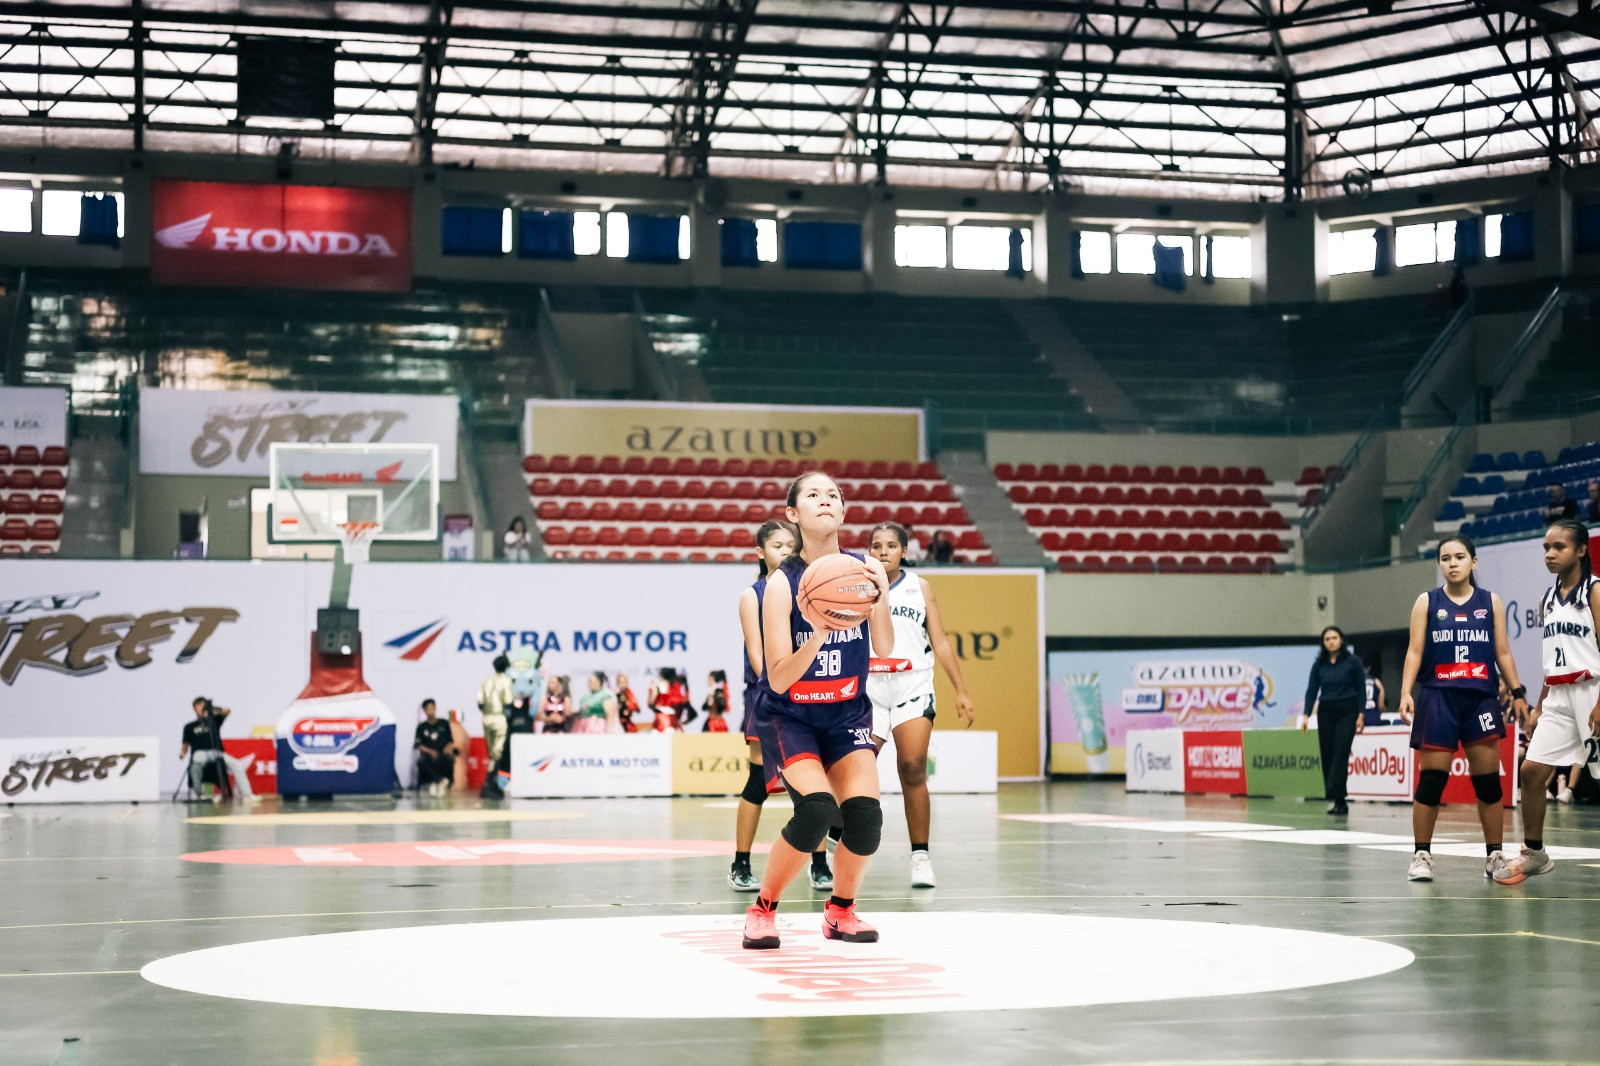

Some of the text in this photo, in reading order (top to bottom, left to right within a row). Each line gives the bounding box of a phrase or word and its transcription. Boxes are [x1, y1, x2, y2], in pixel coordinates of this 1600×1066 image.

[213, 228, 397, 257] HONDA
[889, 605, 922, 622] ARRY
[457, 631, 688, 652] ASTRA MOTOR
[1432, 630, 1490, 643] BUDI UTAMA
[815, 649, 841, 677] 38
[1454, 645, 1469, 664] 12
[1555, 646, 1567, 668] 21
[793, 692, 808, 701] One
[809, 692, 836, 701] HEART.
[1167, 686, 1251, 722] DANCE
[1478, 712, 1496, 732] 12
[560, 758, 659, 768] ASTRA MOTOR
[1, 753, 146, 796] STREET
